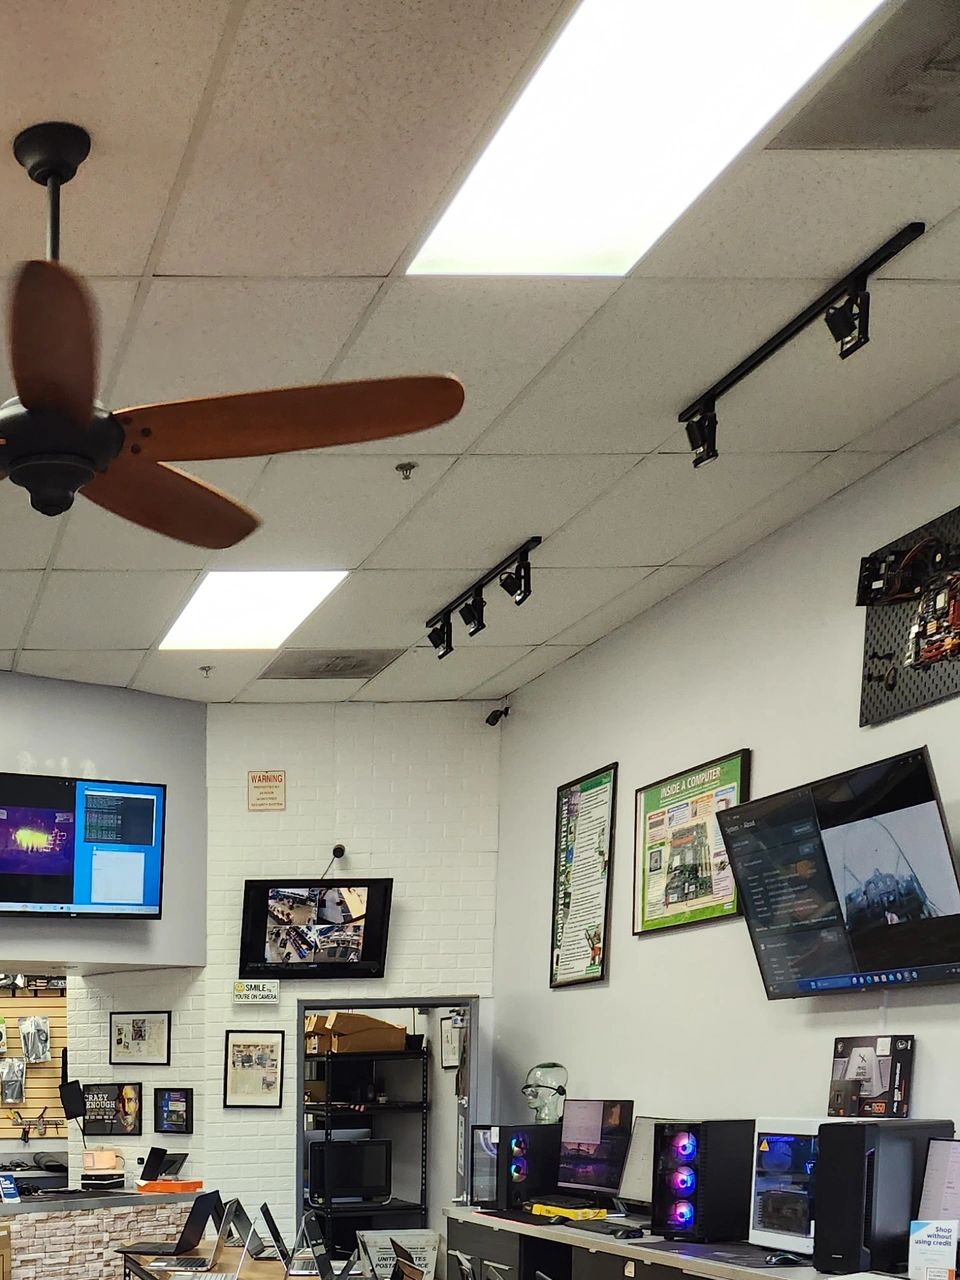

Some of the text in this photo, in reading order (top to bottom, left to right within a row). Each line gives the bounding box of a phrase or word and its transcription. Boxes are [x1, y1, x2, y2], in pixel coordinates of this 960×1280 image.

[251, 775, 283, 783] WARNING
[660, 783, 680, 799] INSIDE
[687, 767, 721, 789] COMPUTER
[556, 884, 566, 946] COMPUTERS
[561, 797, 569, 850] INTERNET
[245, 984, 266, 992] SMILE
[86, 1101, 116, 1109] ENOUGH
[914, 1239, 932, 1247] using
